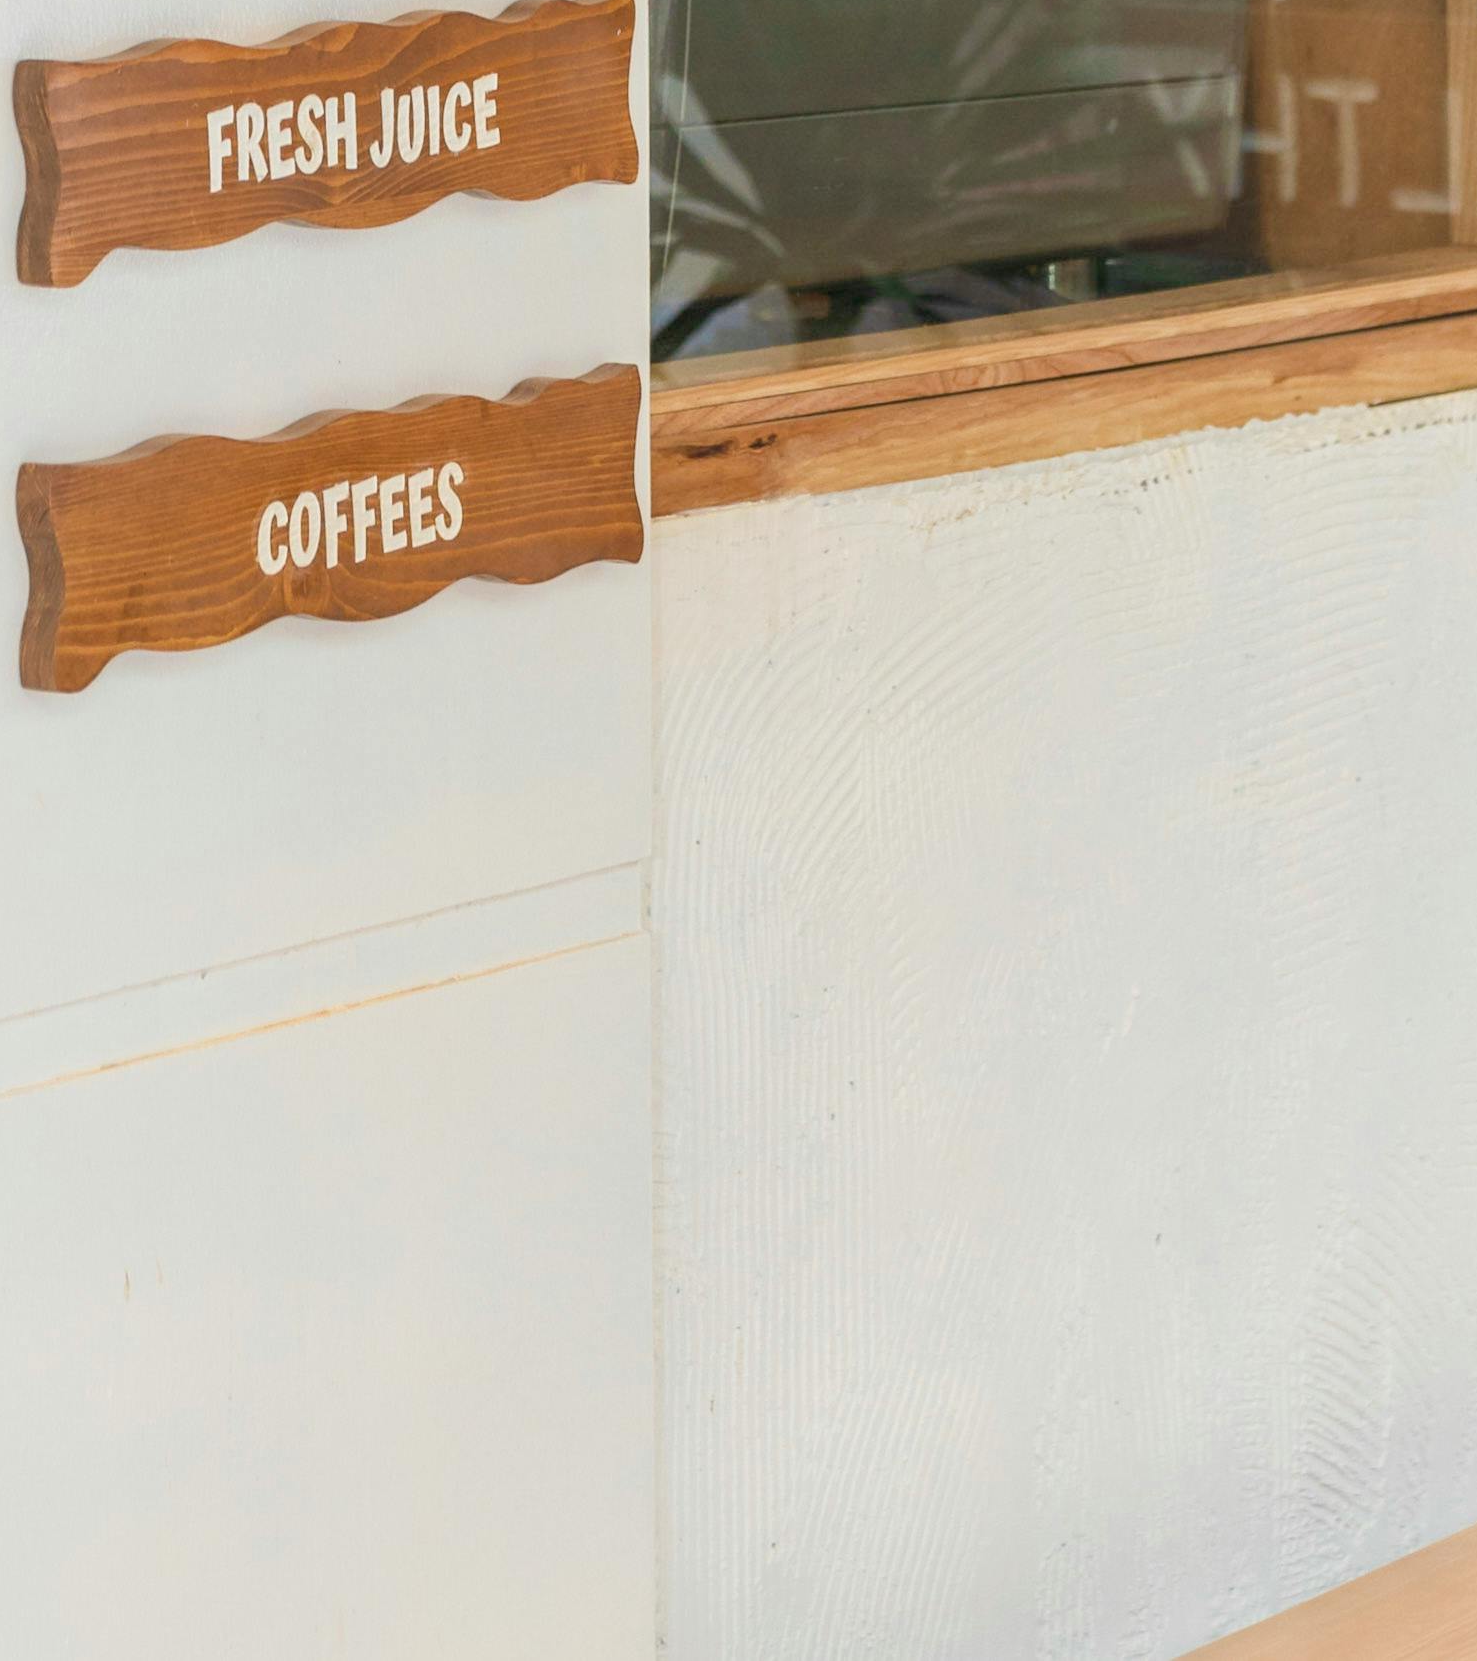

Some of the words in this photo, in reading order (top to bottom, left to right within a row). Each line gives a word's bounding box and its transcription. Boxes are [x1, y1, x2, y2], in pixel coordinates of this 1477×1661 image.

[206, 91, 358, 195] FRESH
[369, 72, 501, 169] JUICE
[255, 460, 466, 577] COFFEES
